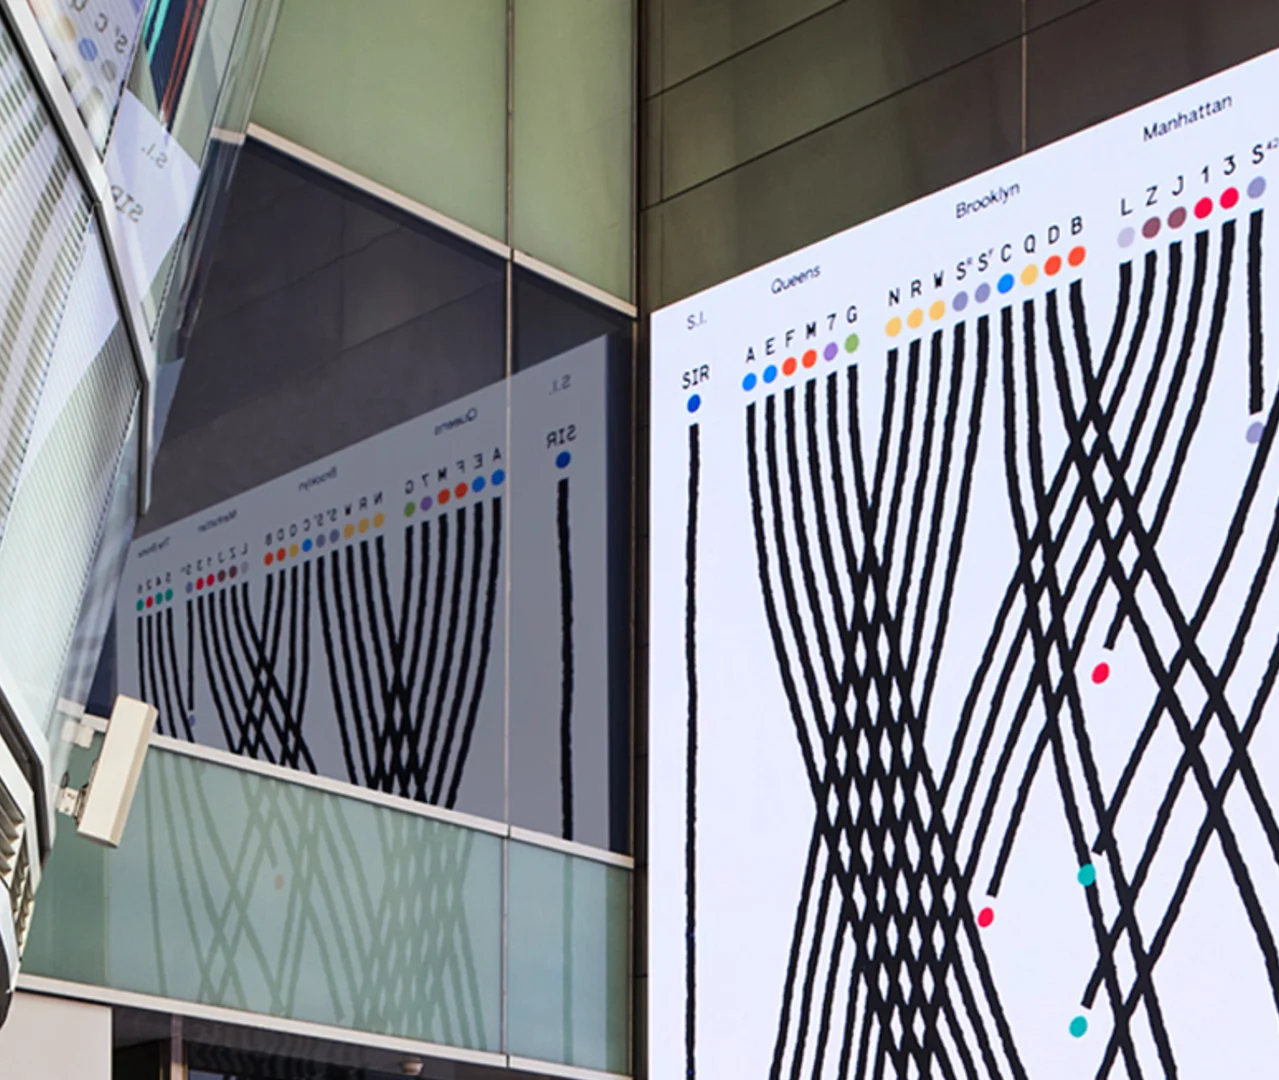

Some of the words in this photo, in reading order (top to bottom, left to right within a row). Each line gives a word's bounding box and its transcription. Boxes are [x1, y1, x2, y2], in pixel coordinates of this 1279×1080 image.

[1142, 95, 1233, 142] Manhattan
[954, 183, 1021, 219] Brooklyn
[1120, 198, 1134, 216] L
[1145, 185, 1159, 208] Z
[1171, 175, 1185, 197] J
[1200, 166, 1211, 184] 1
[1223, 155, 1237, 176] 3
[771, 265, 821, 294] Queens
[888, 287, 901, 307] N
[910, 279, 923, 298] R
[933, 270, 945, 289] W
[1000, 243, 1013, 263] C
[1023, 234, 1037, 254] Q
[1047, 224, 1061, 245] D
[1070, 215, 1084, 236] B
[686, 310, 708, 331] S.I.
[746, 346, 756, 364] A
[765, 336, 776, 356] E
[785, 328, 796, 348] F
[806, 321, 817, 340] M
[826, 312, 837, 331] 7
[846, 305, 858, 324] G
[681, 363, 711, 390] SIR
